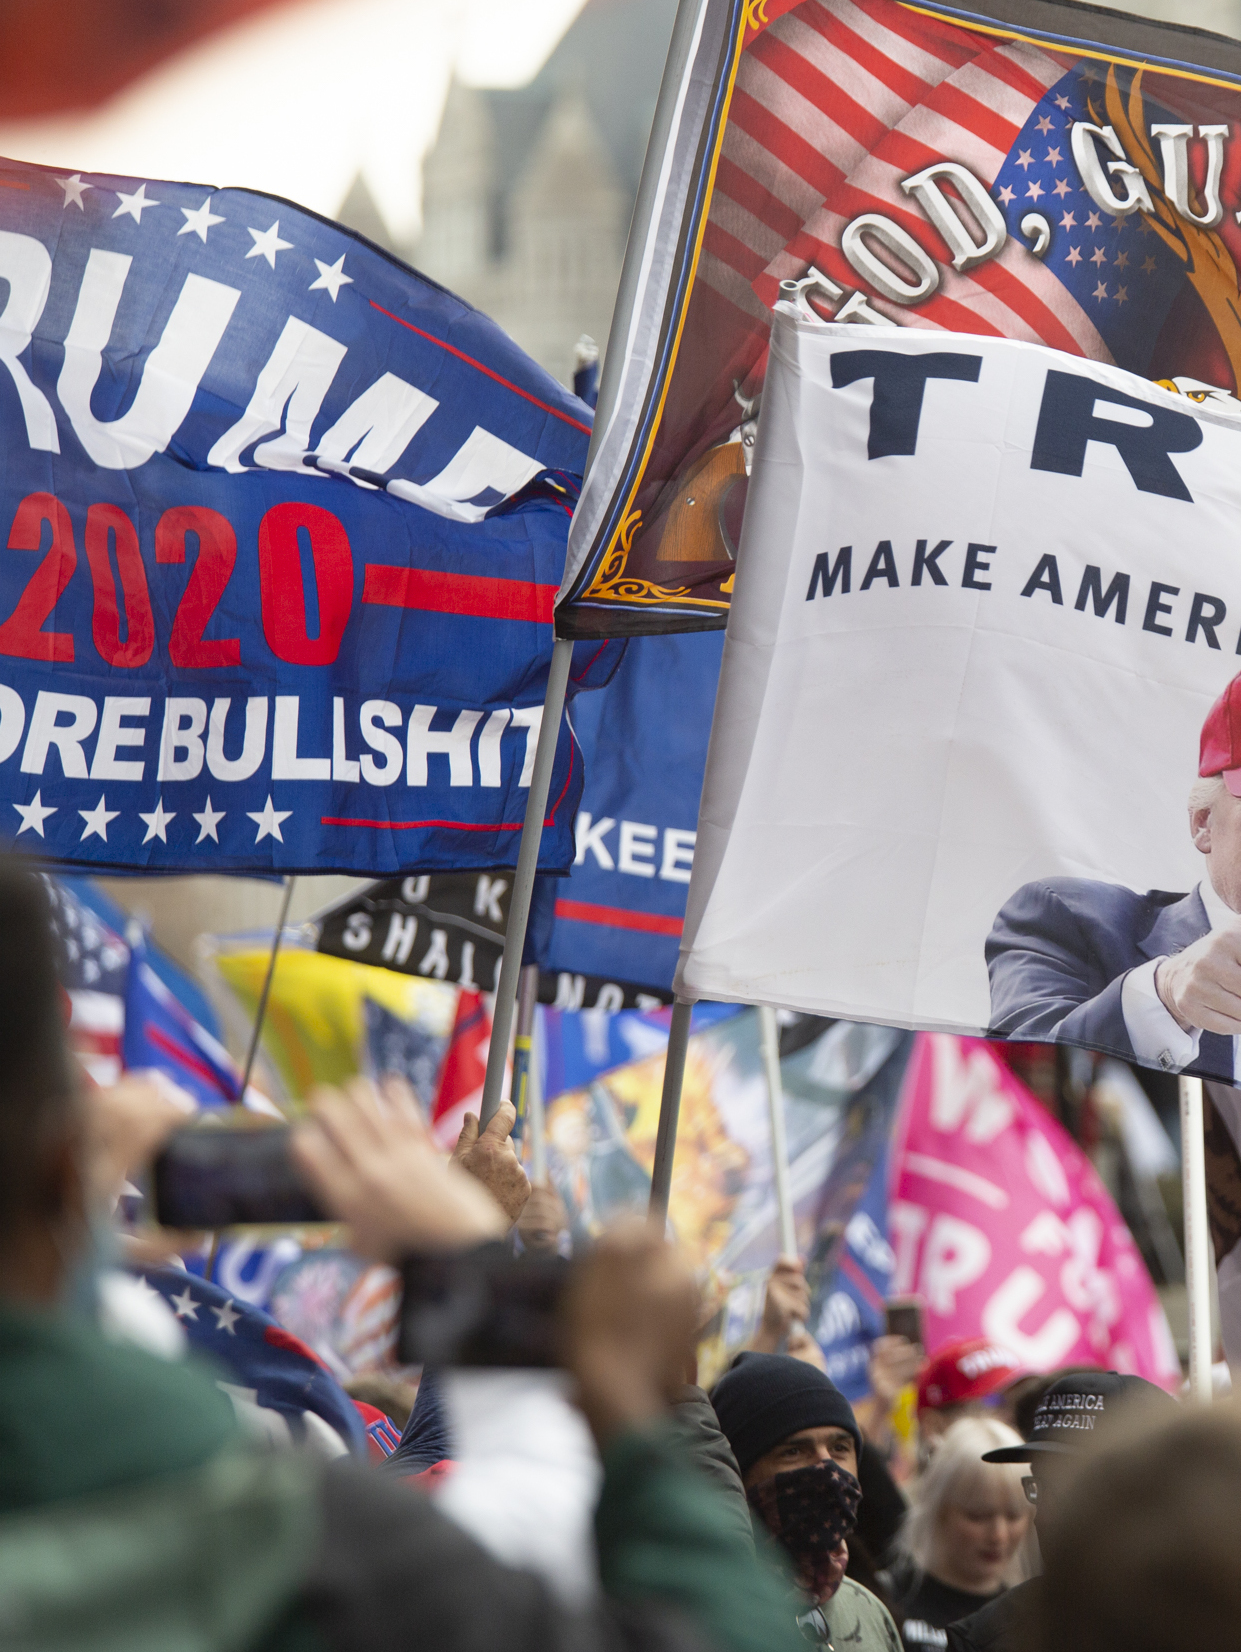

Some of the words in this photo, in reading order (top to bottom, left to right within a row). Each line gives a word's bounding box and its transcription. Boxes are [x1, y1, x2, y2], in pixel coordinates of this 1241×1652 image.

[797, 162, 1051, 328] GOD,
[0, 492, 355, 668] 2020
[805, 539, 998, 601] MAKE
[573, 811, 698, 884] KEE
[343, 911, 503, 993] SHAL
[1052, 1414, 1097, 1430] AGAIN
